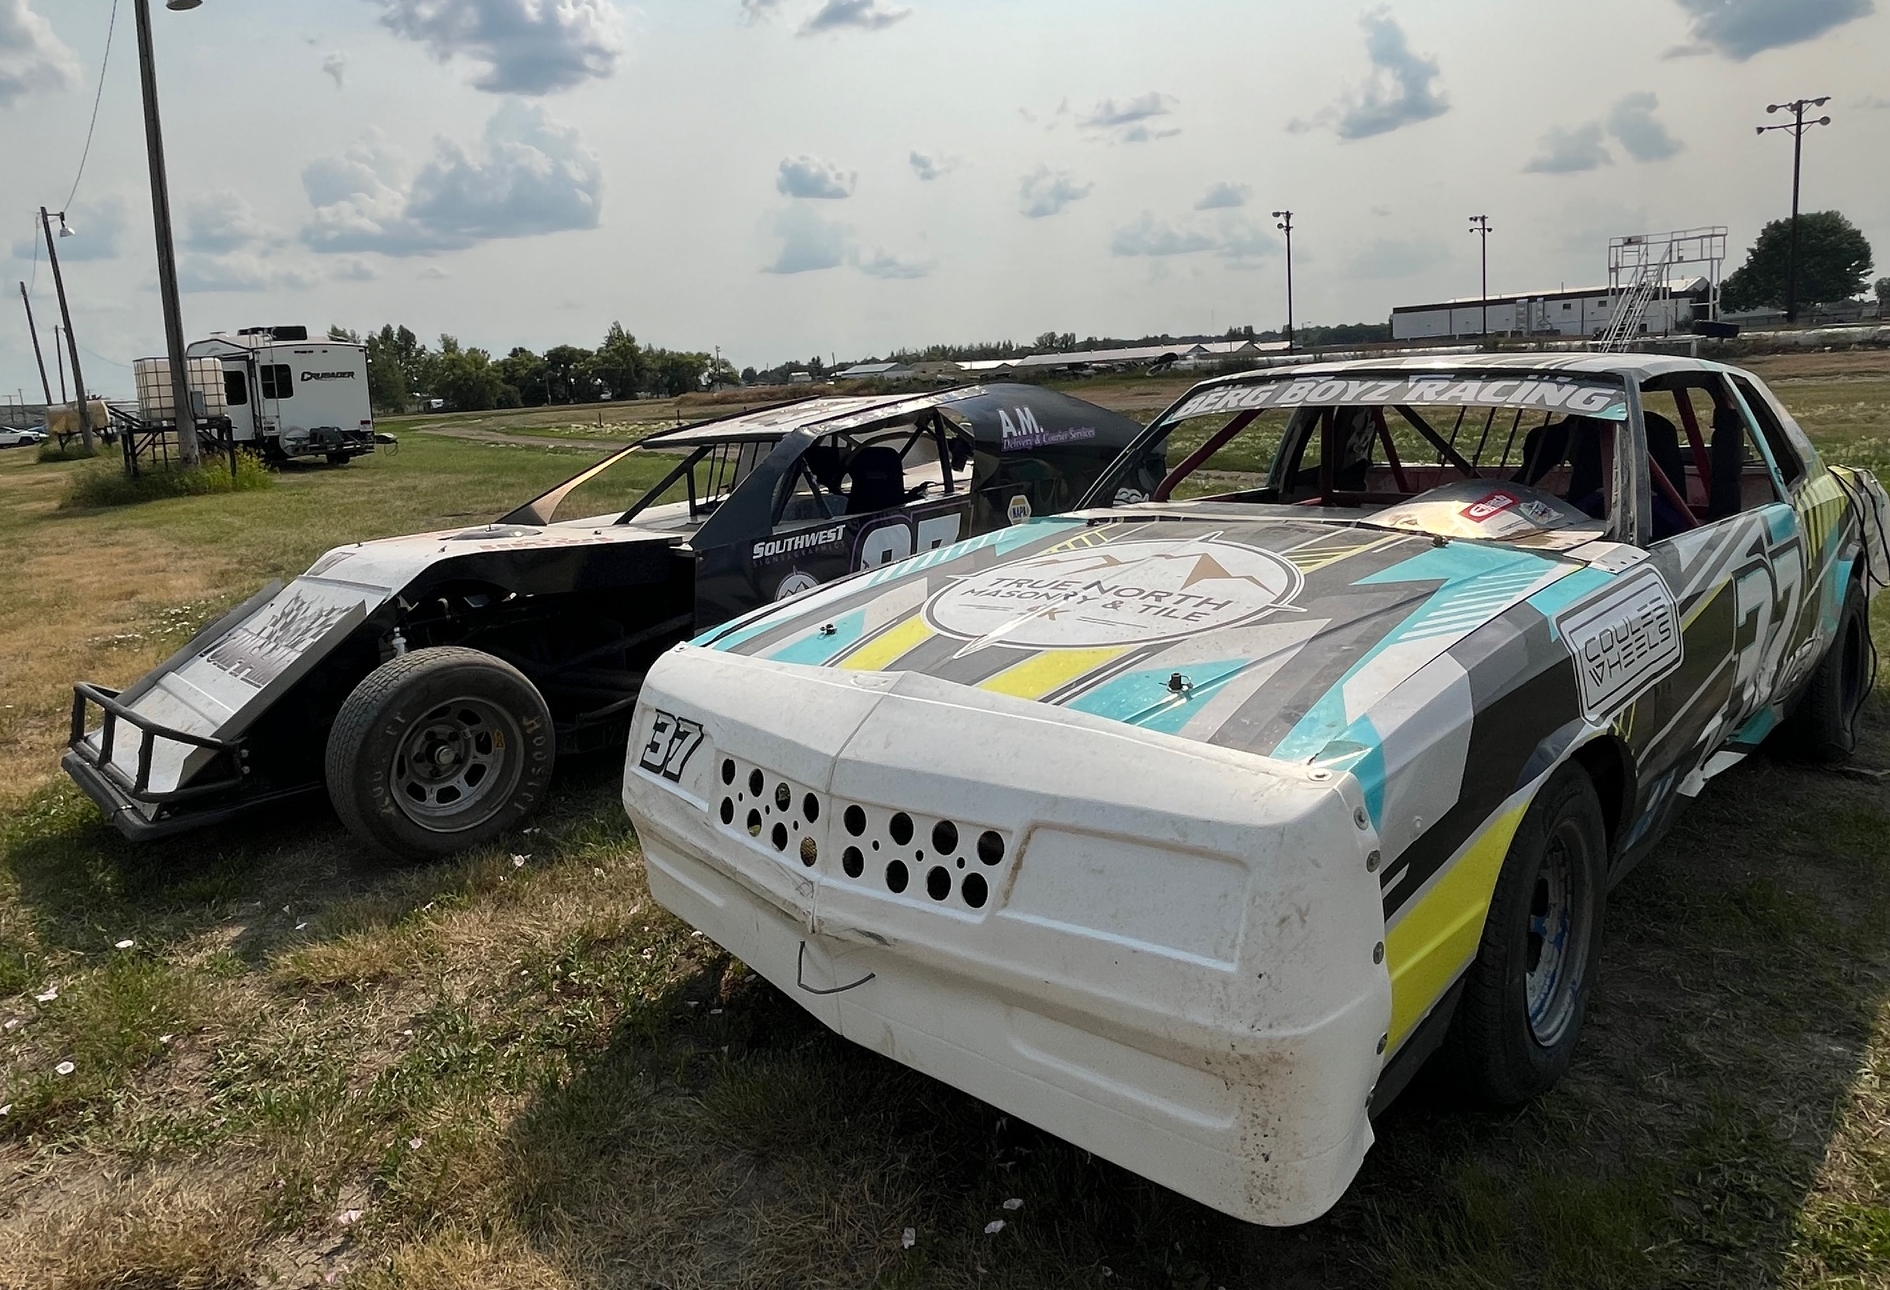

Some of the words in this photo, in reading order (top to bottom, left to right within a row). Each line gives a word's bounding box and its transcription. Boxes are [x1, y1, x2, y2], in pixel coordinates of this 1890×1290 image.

[300, 371, 356, 381] CRUSADER
[1177, 385, 1279, 418] BERG
[1281, 379, 1404, 404] BOYZ
[1404, 379, 1616, 411] RACING
[998, 406, 1044, 438] A.M.
[1002, 437, 1034, 451] Delivery
[1034, 434, 1042, 446] &
[1042, 430, 1068, 445] Courier
[1068, 427, 1096, 440] Services
[752, 525, 847, 559] SOUTHWEST
[959, 587, 1099, 606] MASONRY
[1101, 600, 1121, 612] &
[1136, 604, 1211, 623] TILE
[986, 576, 1085, 592] TRUE
[1081, 579, 1235, 612] NORTH
[1584, 596, 1670, 663] COULEE
[1588, 619, 1672, 688] WHEELS
[639, 708, 705, 783] 37
